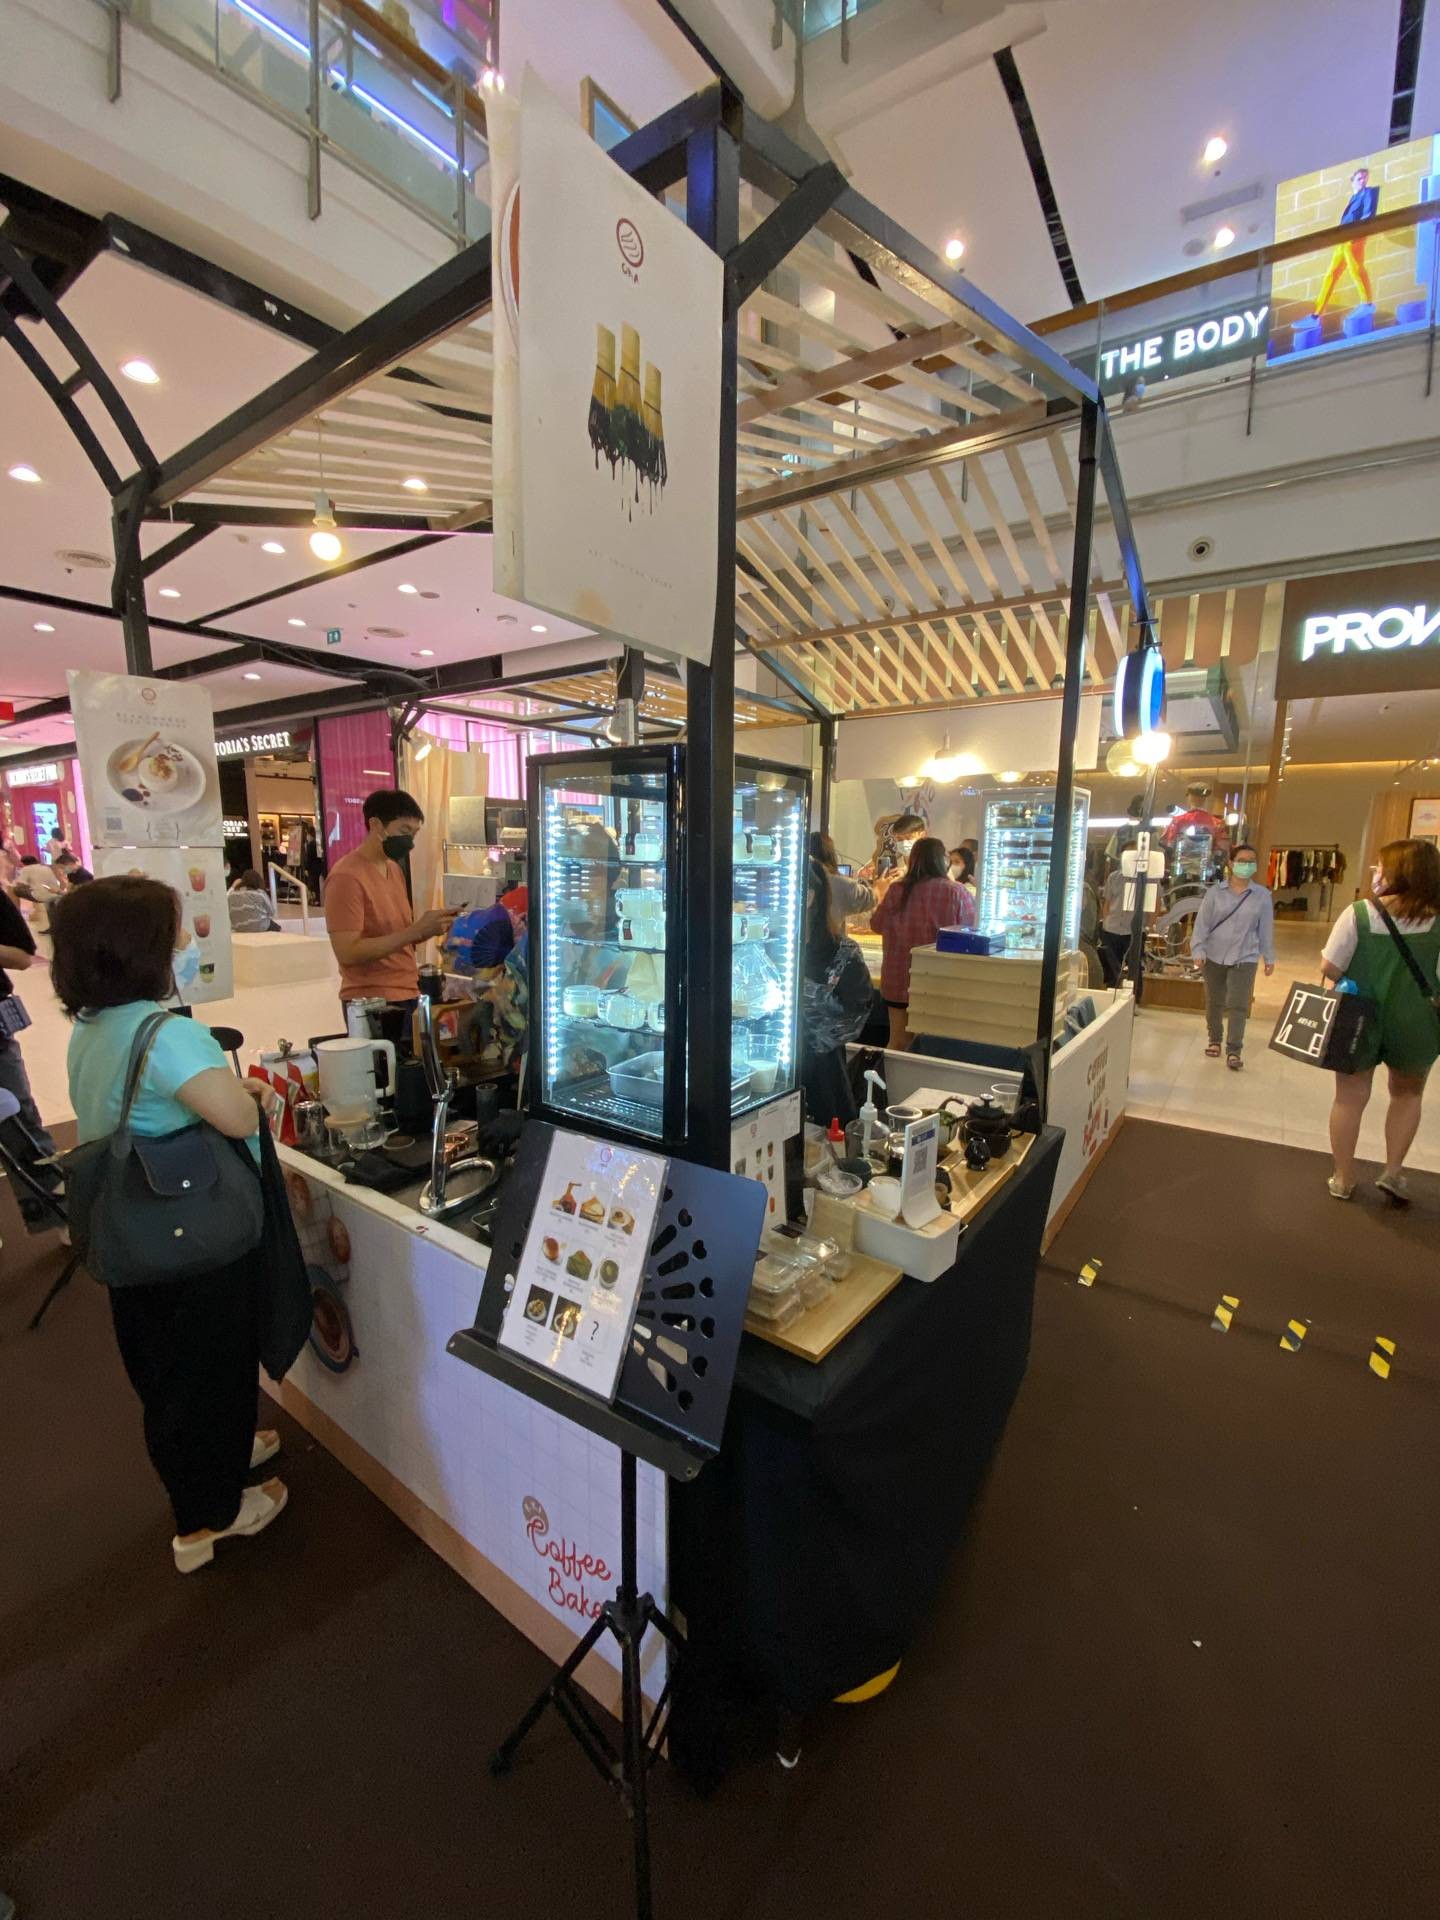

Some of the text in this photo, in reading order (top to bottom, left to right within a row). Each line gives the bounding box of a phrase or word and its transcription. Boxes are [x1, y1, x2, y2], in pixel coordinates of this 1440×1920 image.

[1101, 306, 1269, 380] THE BODY
[251, 731, 290, 751] SECRET
[527, 1518, 612, 1581] Coffee
